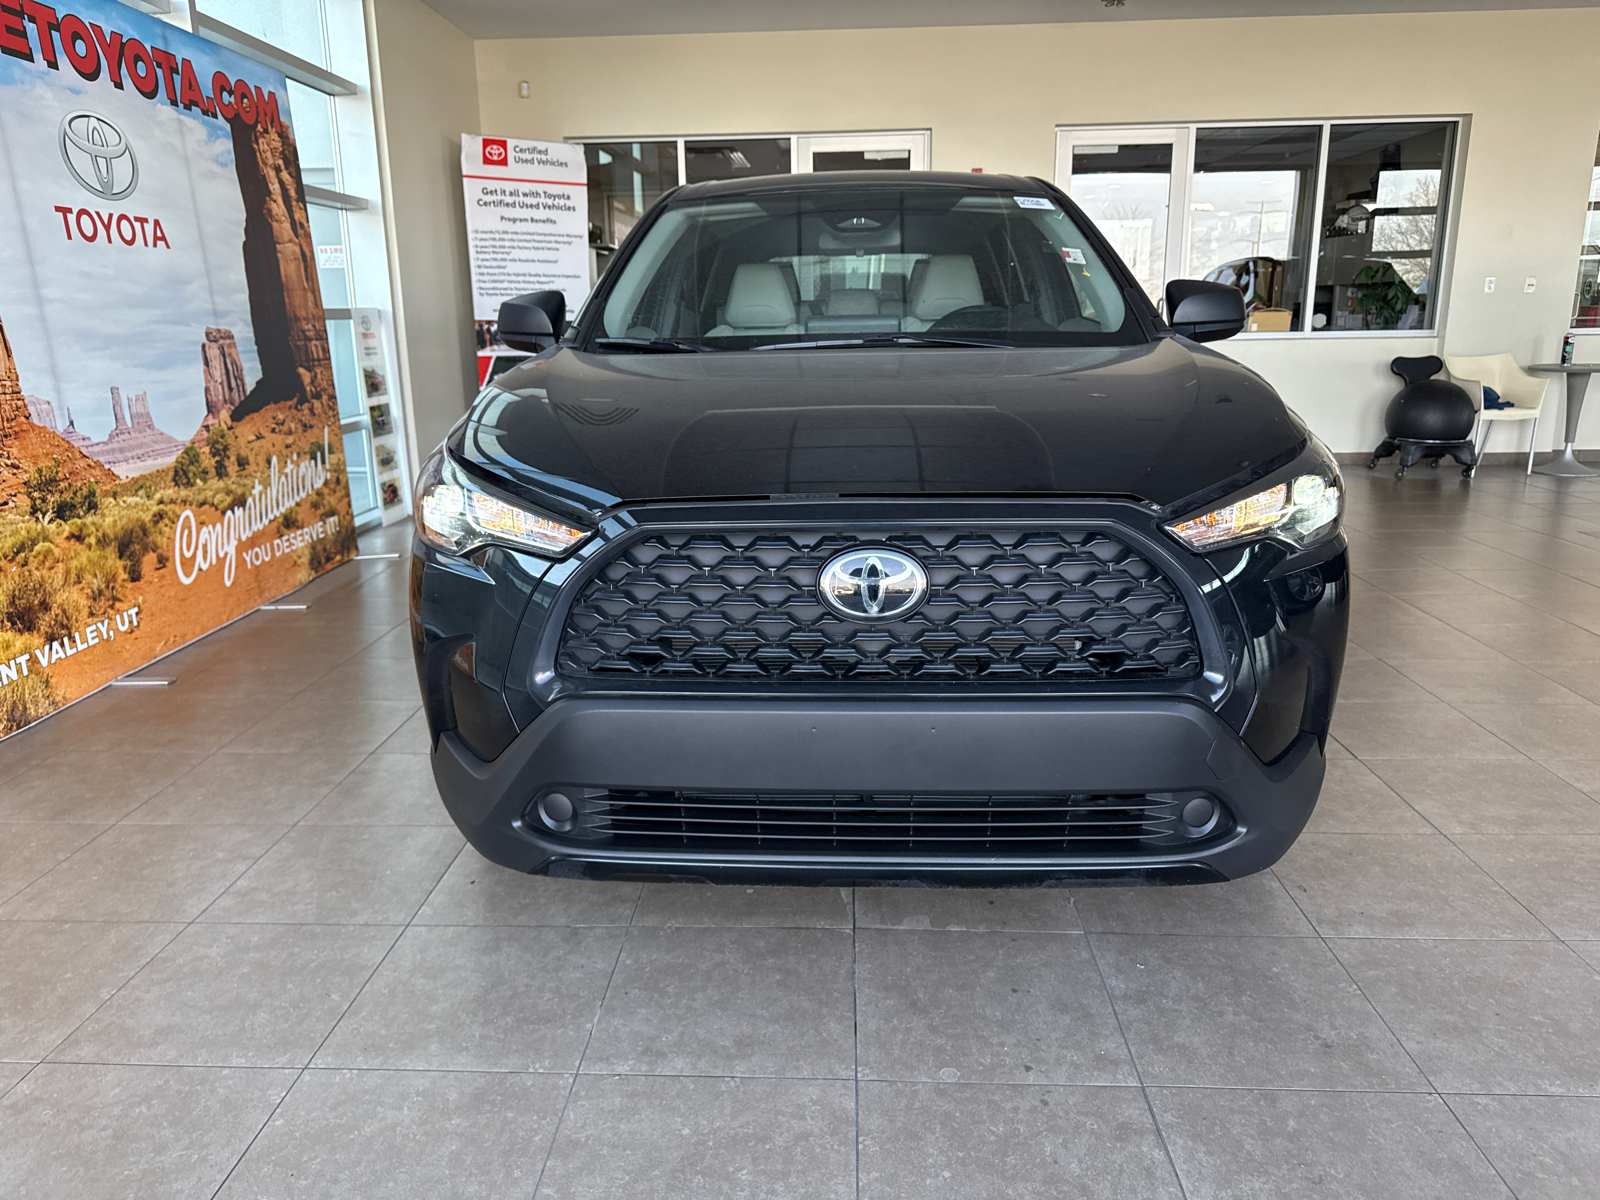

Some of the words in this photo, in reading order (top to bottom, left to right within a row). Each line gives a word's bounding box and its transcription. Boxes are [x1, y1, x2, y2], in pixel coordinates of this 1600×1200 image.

[513, 144, 549, 156] Certified
[513, 156, 535, 165] Used
[537, 157, 569, 168] Vehicles
[481, 187, 499, 196] Get
[500, 188, 507, 197] it
[508, 188, 521, 198] all
[522, 189, 542, 199] with
[543, 190, 571, 202] Toyota
[476, 198, 517, 209] Certified
[518, 200, 541, 211] Used
[541, 202, 576, 213] Vehicles
[54, 204, 171, 250] TOYOTA
[500, 215, 529, 225] Program
[530, 216, 557, 225] Benefits
[174, 426, 330, 587] Congratulations!
[242, 544, 272, 569] YOU
[274, 520, 324, 557] DESERVE
[323, 515, 339, 540] IT!
[0, 653, 30, 688] NT
[34, 618, 114, 668] VALLEY,
[117, 606, 140, 633] UT
